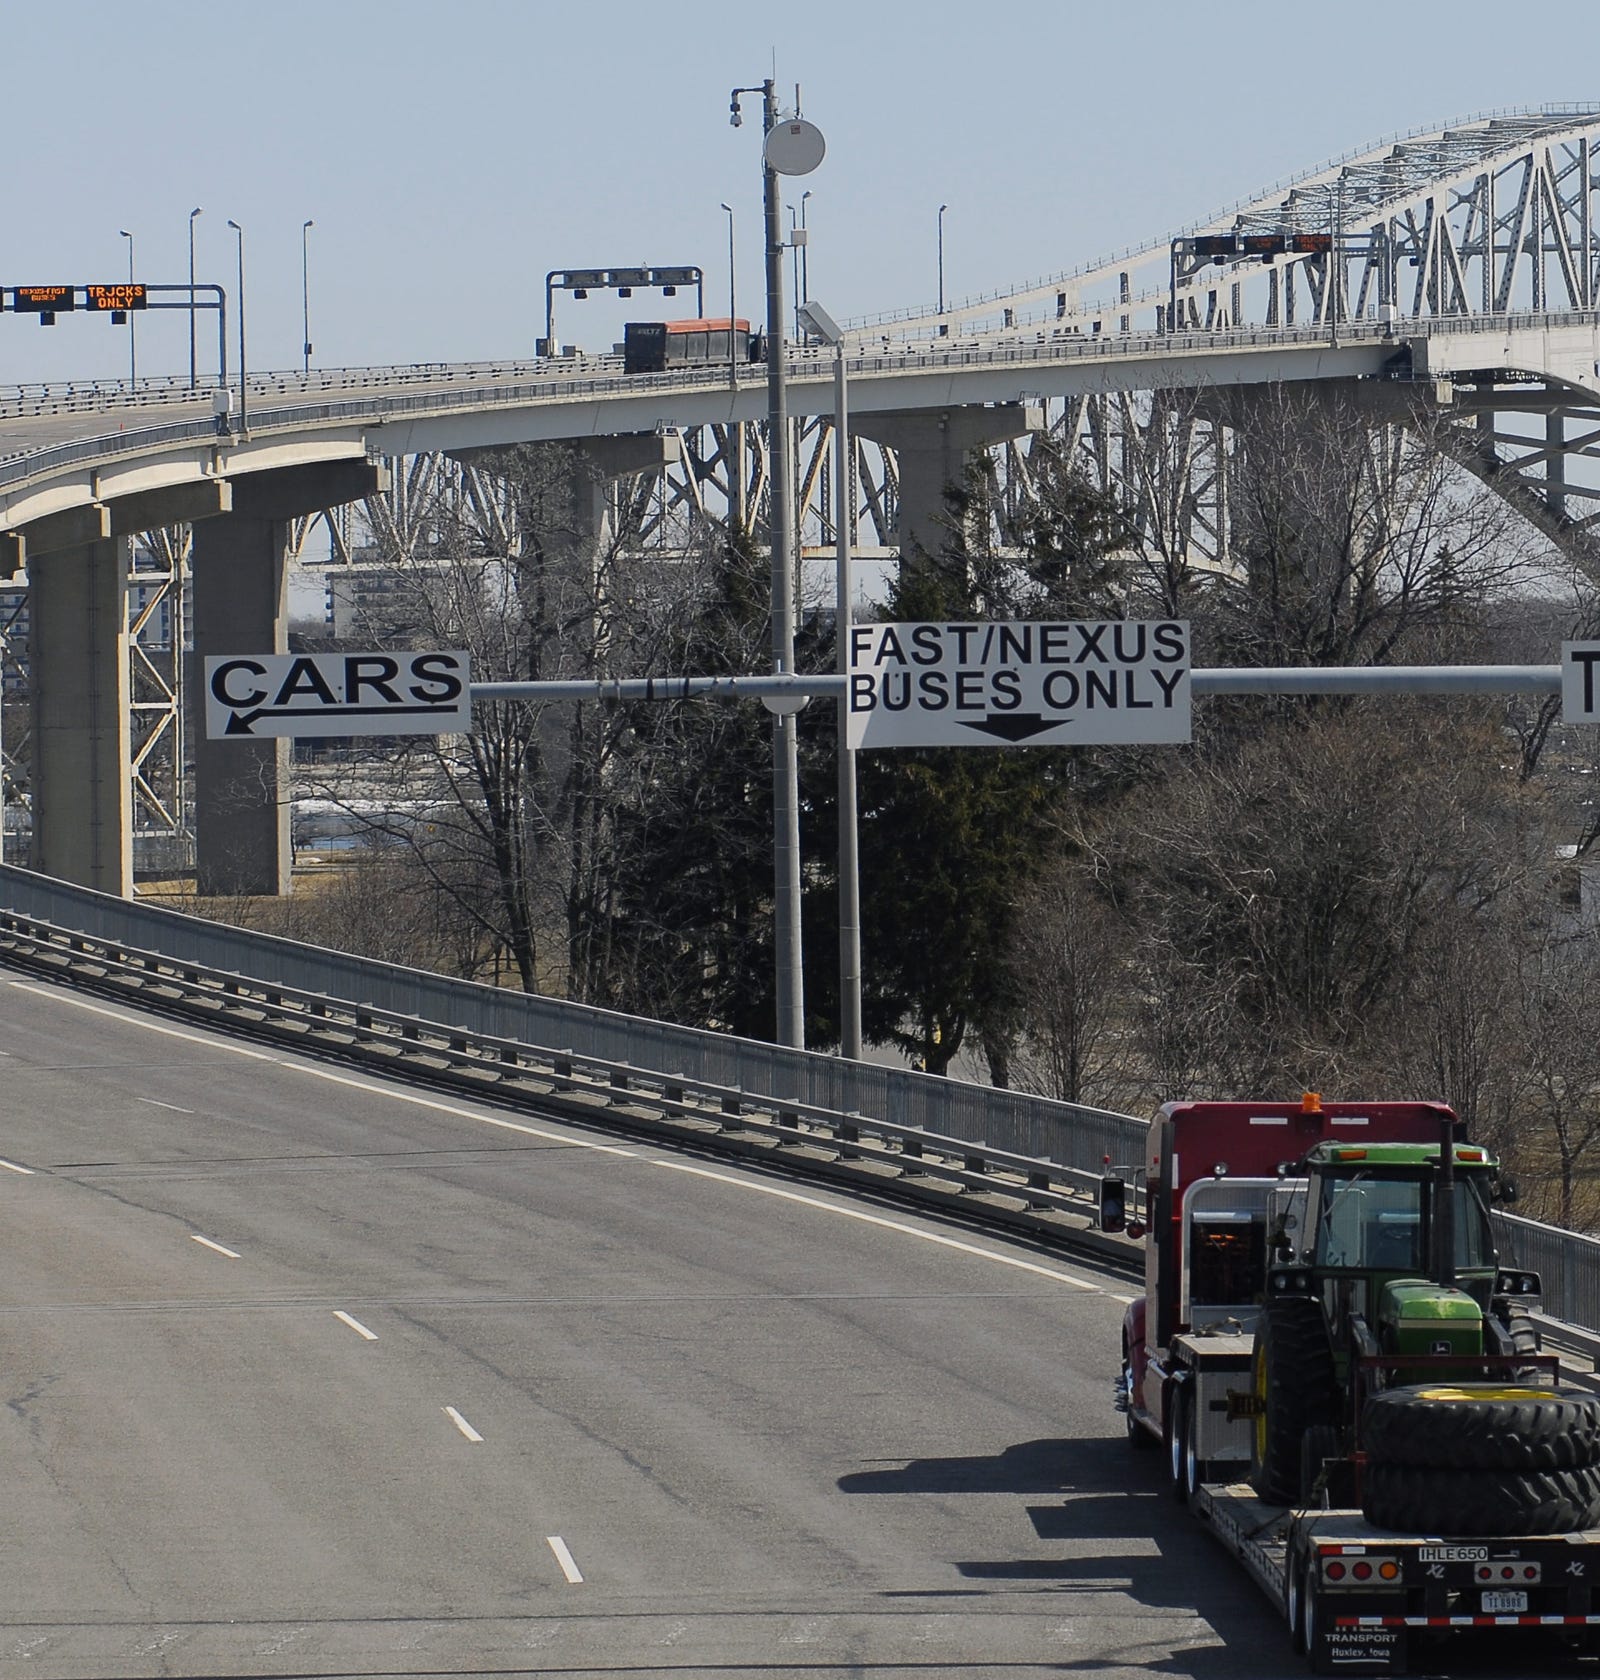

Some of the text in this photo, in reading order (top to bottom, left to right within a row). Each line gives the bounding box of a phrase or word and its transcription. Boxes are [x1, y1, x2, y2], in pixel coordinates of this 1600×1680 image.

[98, 297, 133, 308] ONLY
[850, 623, 1186, 667] FAST/NEXUS
[210, 654, 463, 708] CARS
[850, 669, 1186, 713] BUSES ONLY
[1421, 1547, 1487, 1560] IHLE 650
[1324, 1634, 1398, 1642] TRANSPORT
